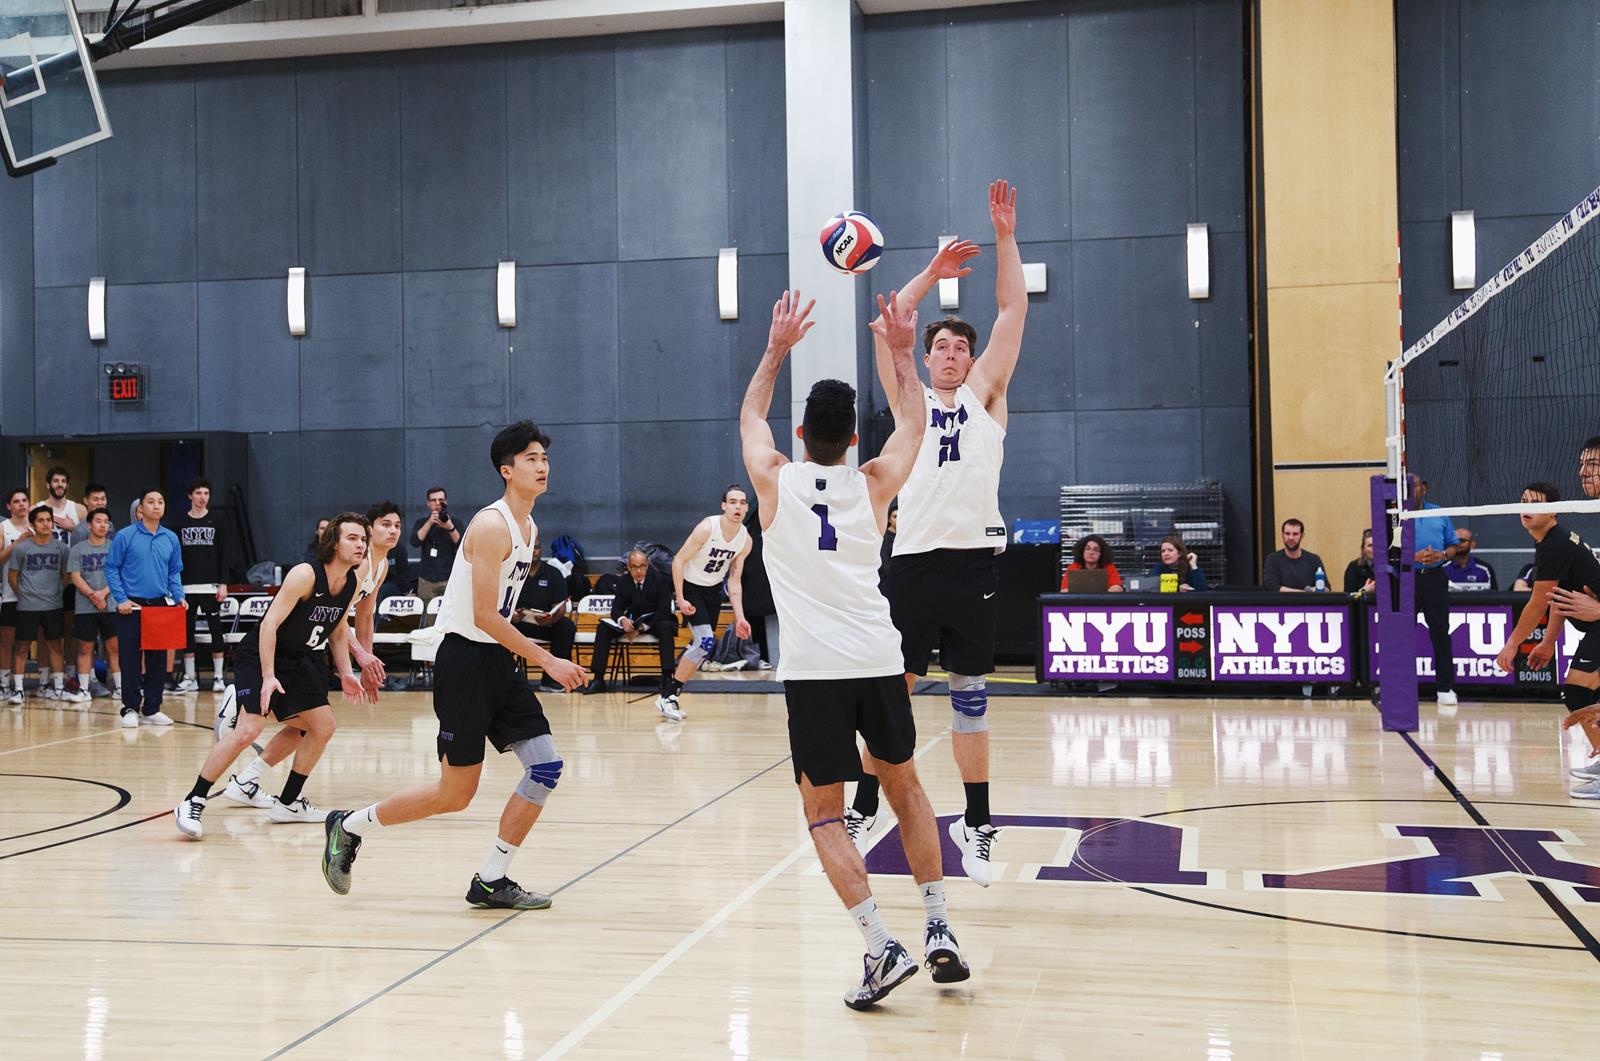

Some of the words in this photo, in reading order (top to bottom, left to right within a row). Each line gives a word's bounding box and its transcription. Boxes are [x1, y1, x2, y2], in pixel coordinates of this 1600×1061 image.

[835, 235, 854, 256] NCAA
[113, 379, 137, 399] EXIT
[182, 527, 215, 540] NYU
[810, 504, 838, 551] 1
[27, 553, 60, 565] NYU
[82, 553, 108, 567] NY
[709, 547, 736, 559] NYU
[390, 599, 415, 608] NYU
[309, 606, 343, 622] NYU
[1048, 612, 1168, 653] NYU
[1176, 627, 1206, 638] POSS
[1218, 612, 1343, 653] NYU
[1049, 655, 1169, 673] ATHLETICS
[1220, 656, 1345, 675] ATHLETICS
[1177, 668, 1207, 678] BONUS
[1519, 671, 1551, 681] BONUS
